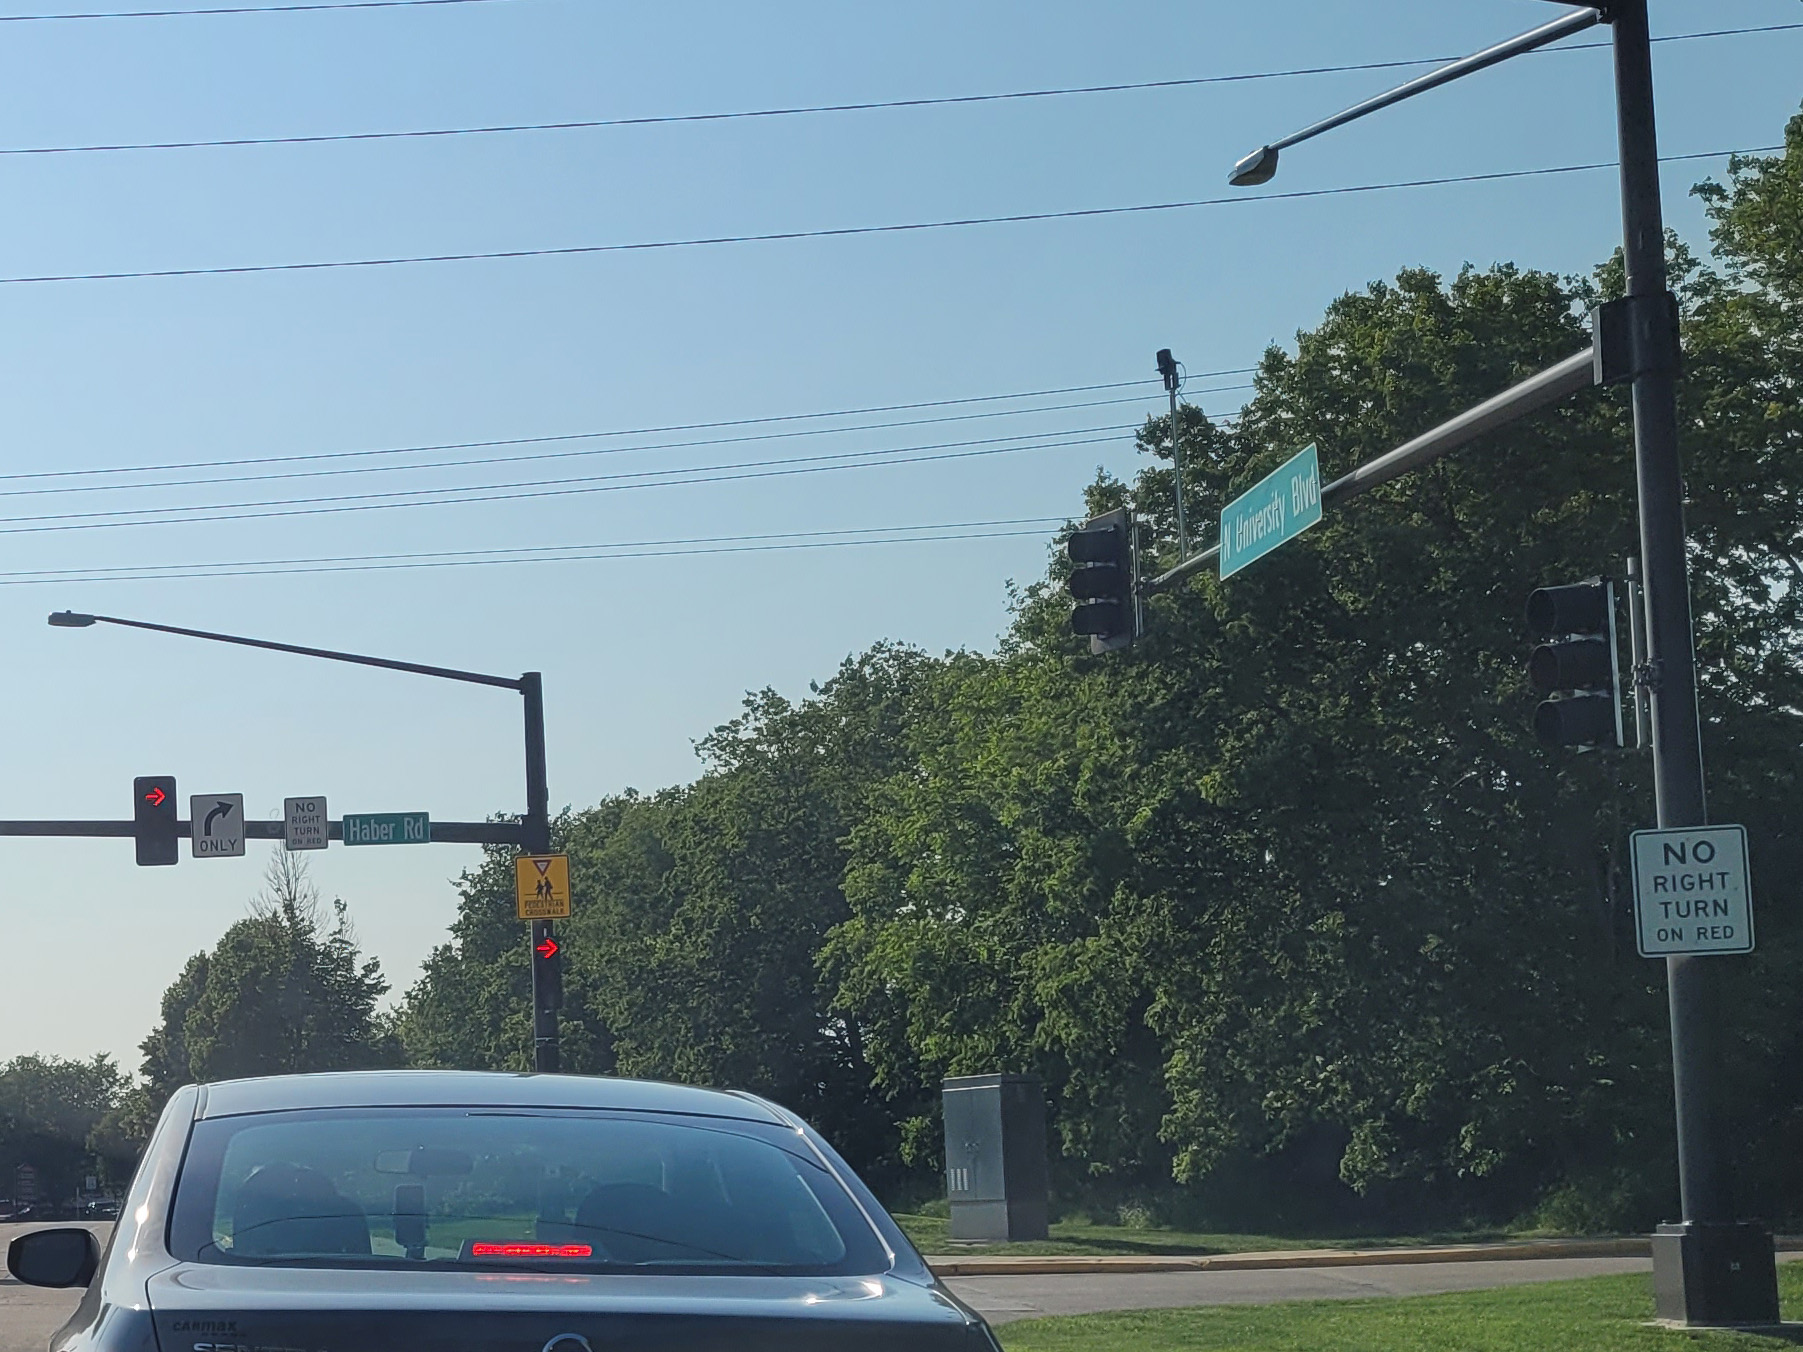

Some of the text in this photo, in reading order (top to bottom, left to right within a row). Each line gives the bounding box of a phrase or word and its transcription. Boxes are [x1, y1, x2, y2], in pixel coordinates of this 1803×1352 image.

[1236, 490, 1286, 553] University
[1291, 463, 1317, 518] Blvd
[295, 802, 316, 813] NO
[291, 815, 321, 824] RIGHT
[349, 817, 424, 841] Haber Rd
[294, 826, 320, 836] TURN
[200, 838, 238, 852] ONLY
[1663, 840, 1716, 866] NO
[1653, 872, 1731, 893] RIGHT
[1659, 898, 1729, 919] TURN
[1657, 925, 1735, 942] ON RED
